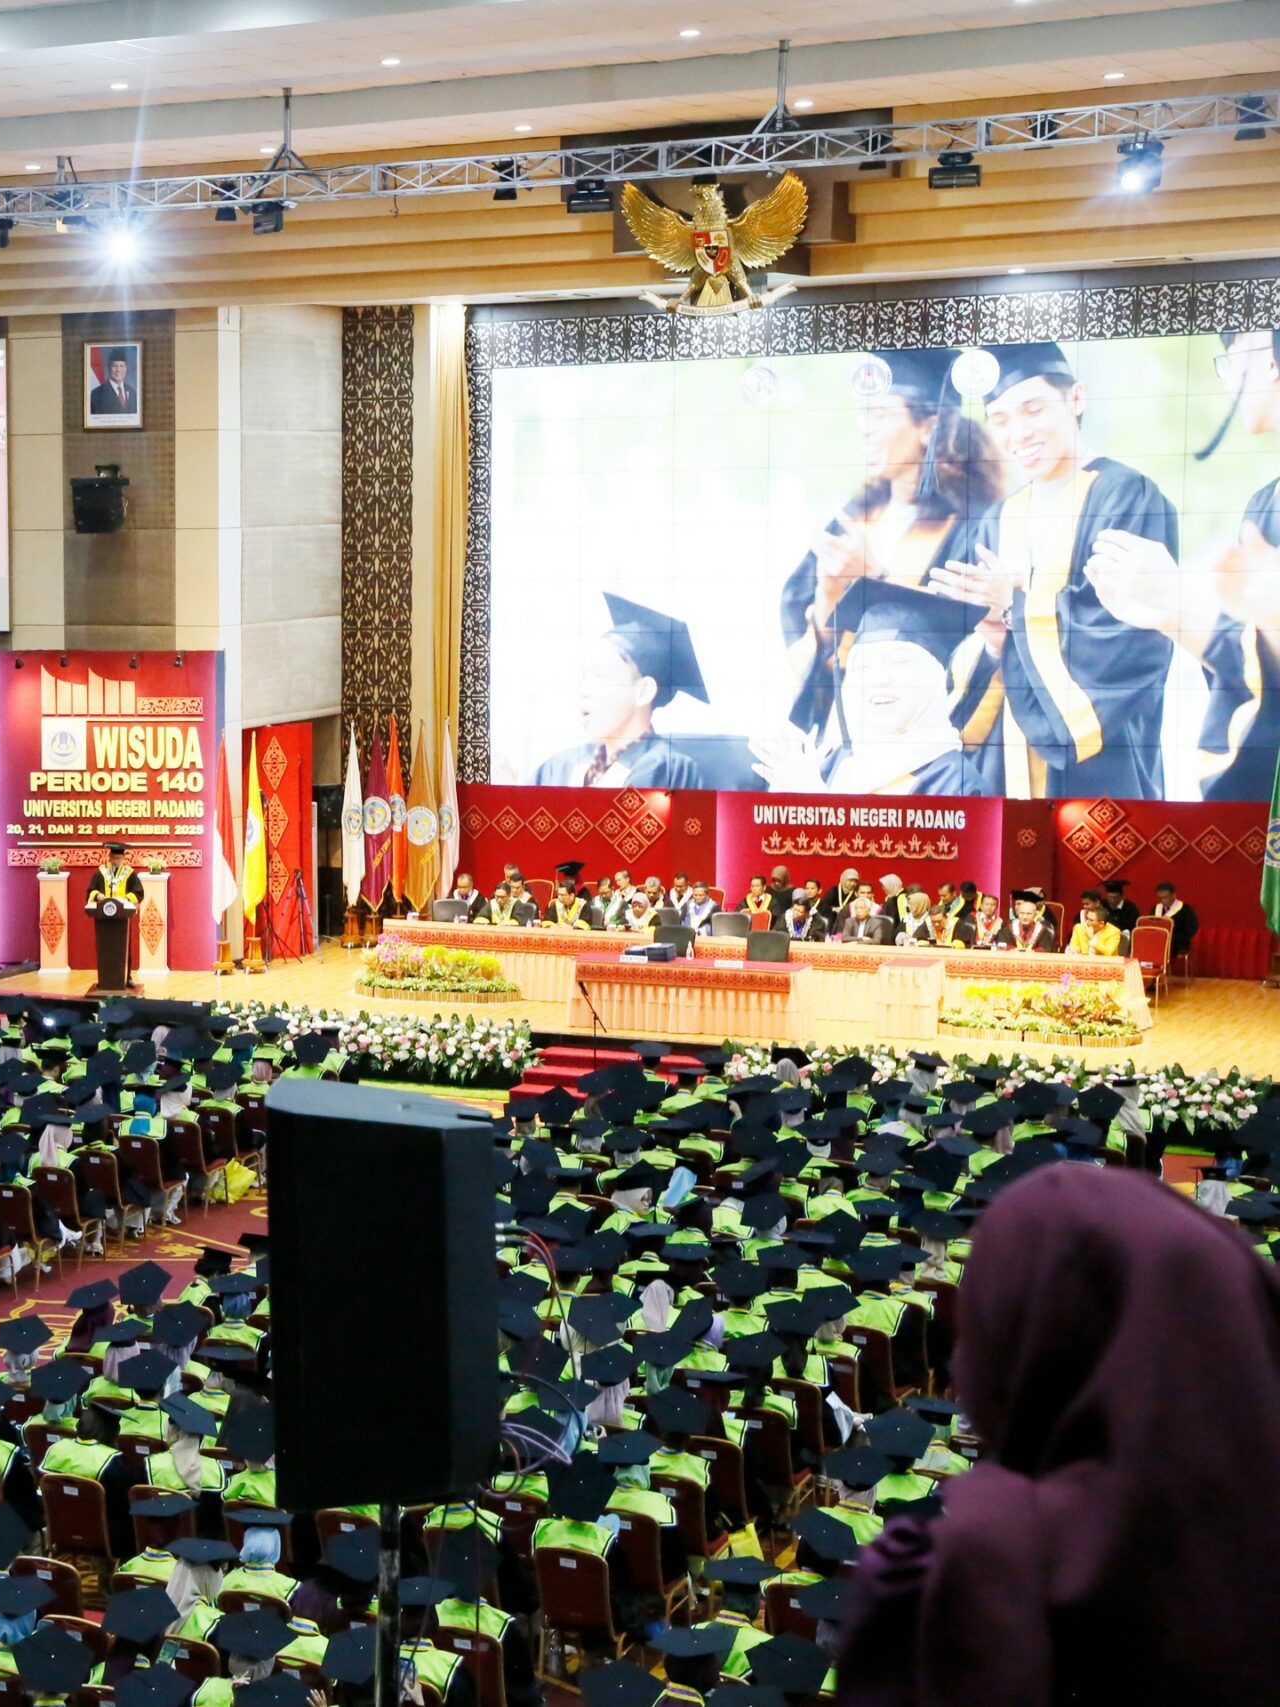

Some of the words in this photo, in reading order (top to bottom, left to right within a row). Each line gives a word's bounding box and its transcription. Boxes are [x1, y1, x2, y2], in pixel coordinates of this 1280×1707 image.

[92, 725, 204, 770] WISUDA
[30, 772, 148, 792] PERIODE
[156, 772, 204, 792] 140
[23, 800, 103, 818] UNIVERSITAS
[106, 800, 151, 818] NEGERI
[153, 800, 205, 818] PADANG
[753, 805, 846, 826] UNIVERSITAS
[850, 808, 903, 828] NEGERI
[906, 809, 966, 830] PADANG
[6, 824, 24, 836] 20,
[28, 824, 45, 836] 21,
[47, 824, 74, 835] DAN
[77, 824, 93, 835] 22
[96, 824, 170, 835] SEPTEMBER
[173, 824, 205, 835] 2025
